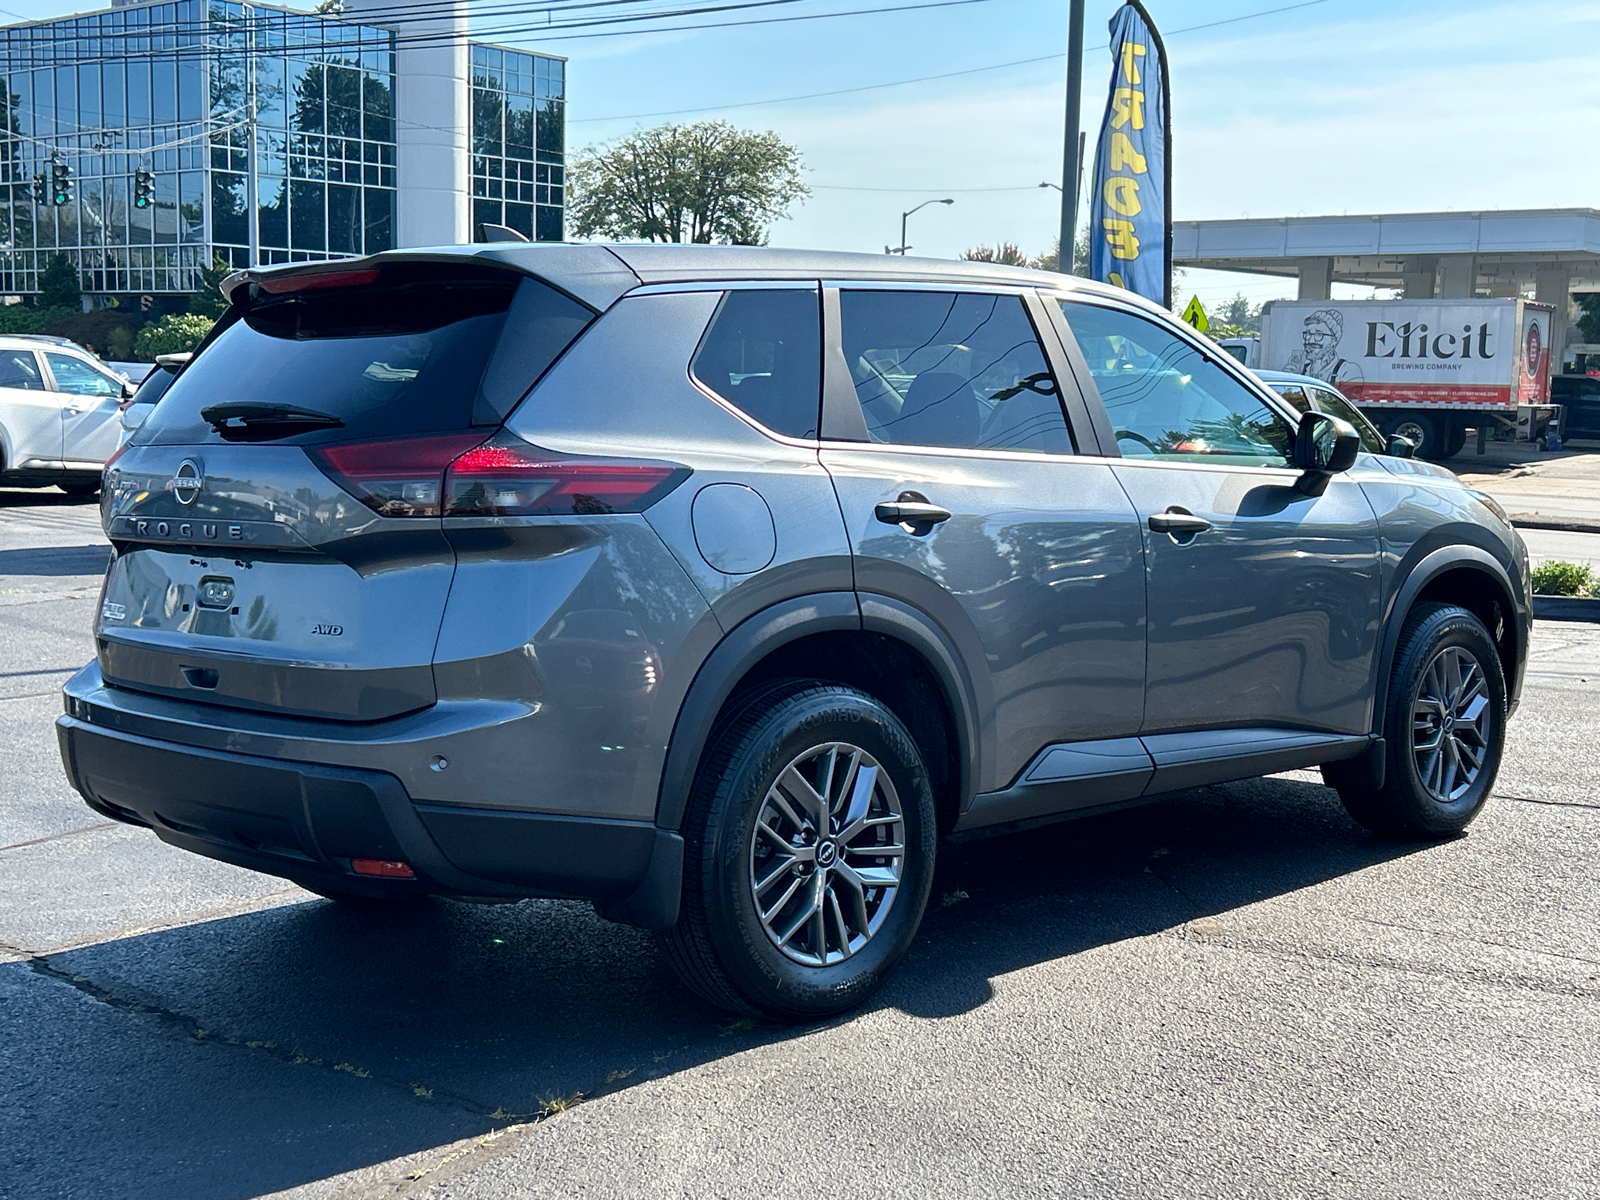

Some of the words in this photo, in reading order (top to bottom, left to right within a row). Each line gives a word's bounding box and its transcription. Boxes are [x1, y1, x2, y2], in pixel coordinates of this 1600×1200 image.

[1364, 321, 1495, 359] Elicit
[173, 479, 202, 487] SSAN
[136, 521, 243, 540] ROGUE
[311, 623, 344, 637] AWD
[799, 708, 862, 734] KUMHO
